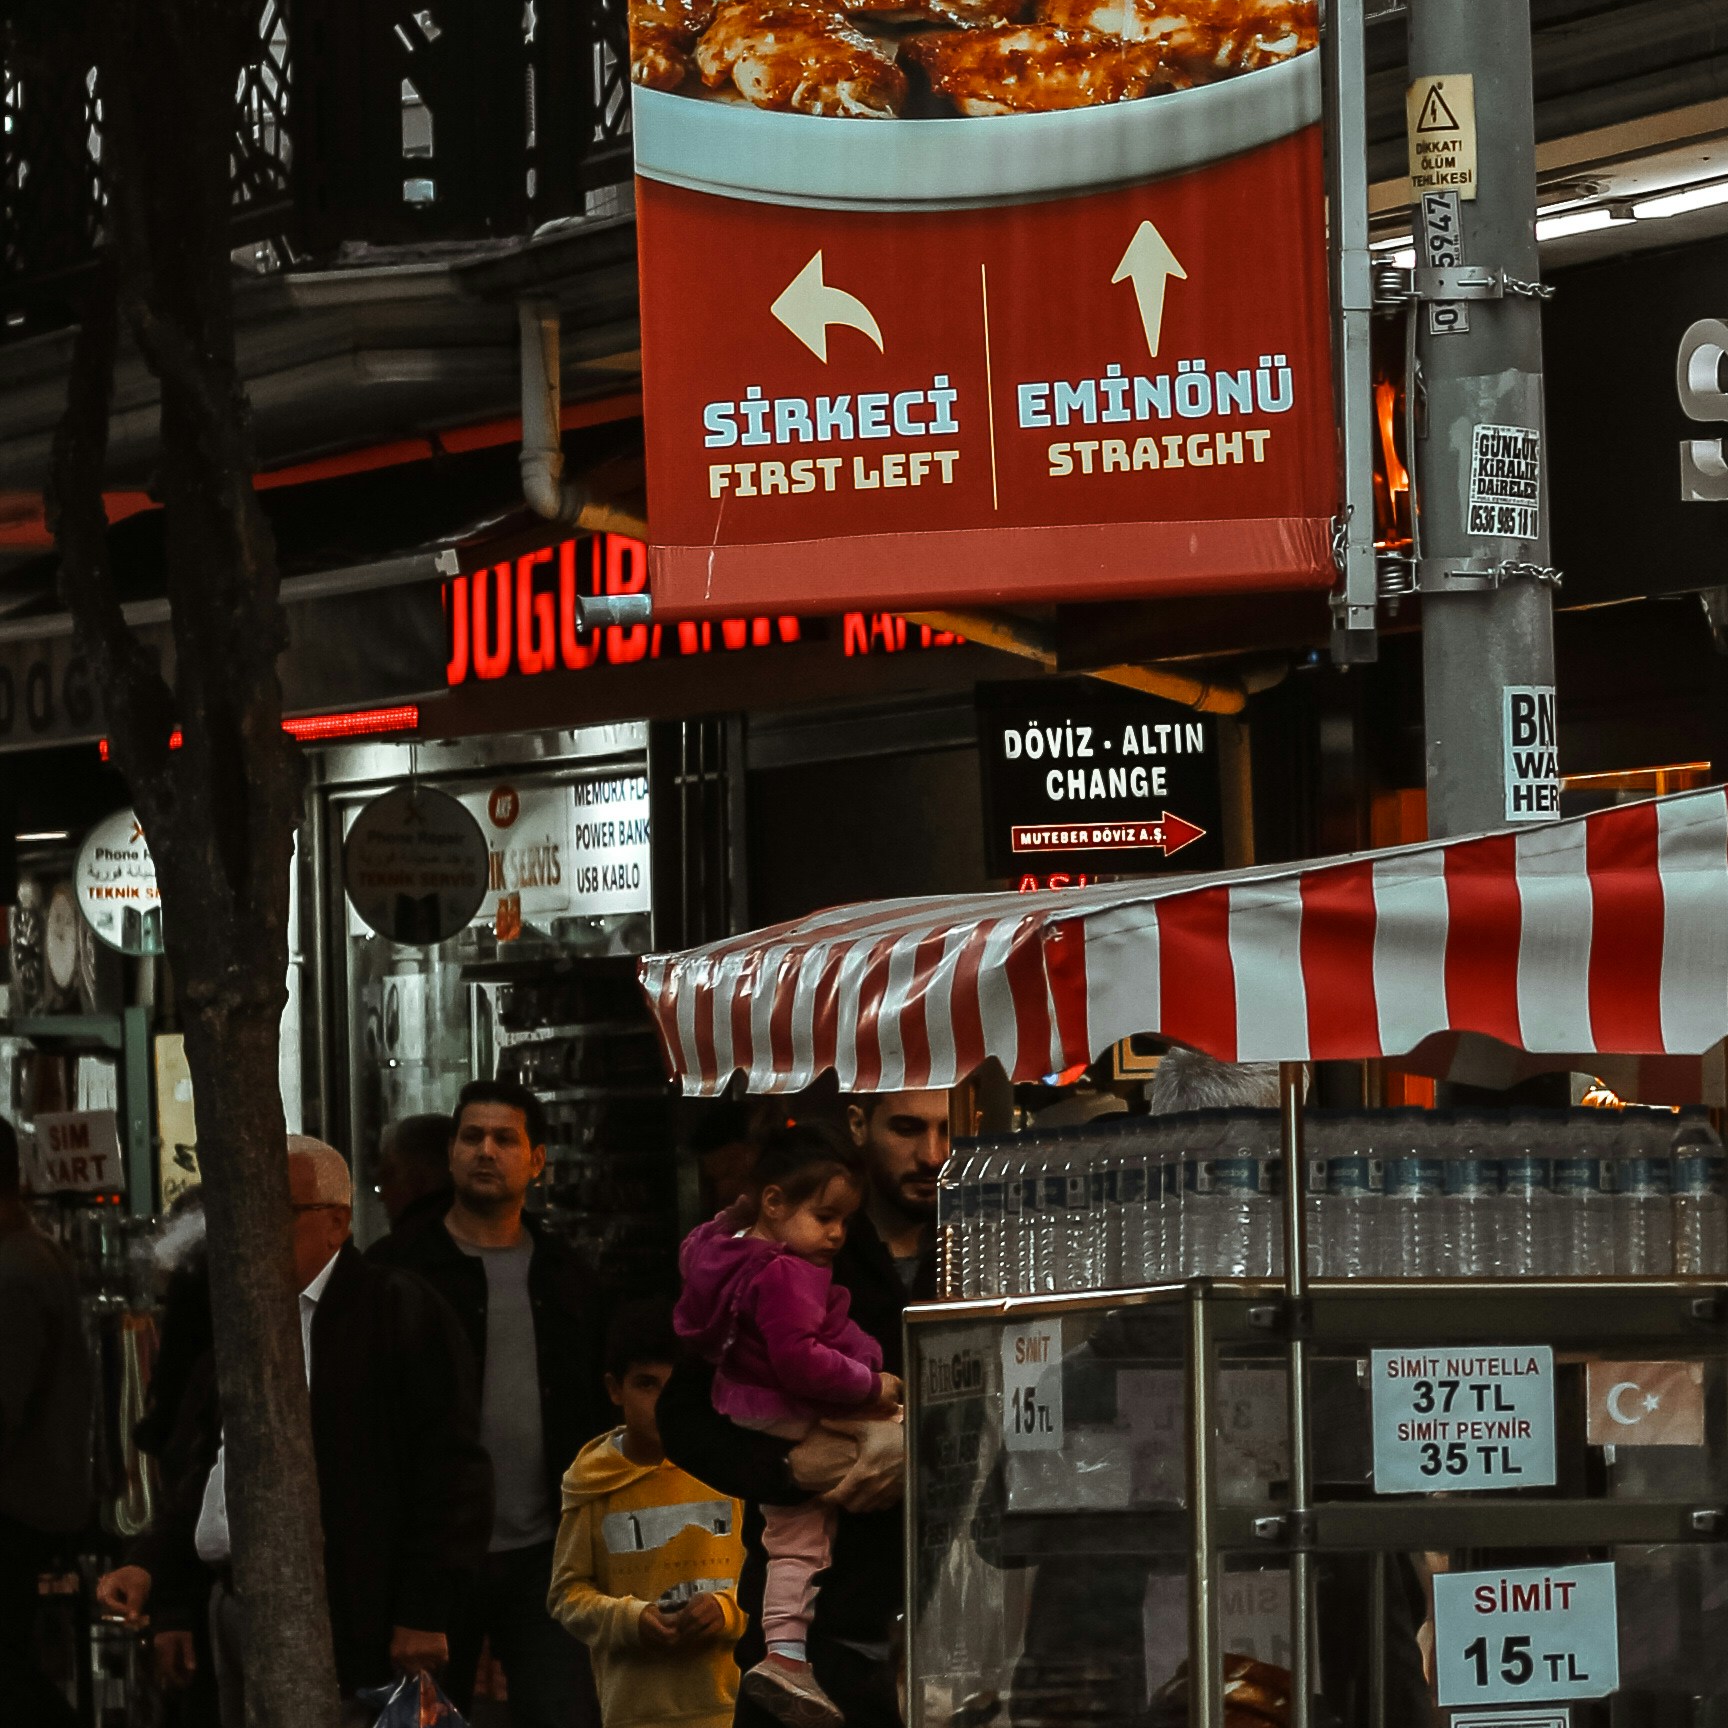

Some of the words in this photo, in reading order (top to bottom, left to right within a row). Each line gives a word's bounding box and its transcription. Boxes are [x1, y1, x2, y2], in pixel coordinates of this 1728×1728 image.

[1415, 139, 1463, 155] DİKKAT!
[1421, 155, 1456, 170] ÖLÜM
[1412, 169, 1472, 187] TEHLİKESİ
[1017, 354, 1294, 428] EMİNÖNÜ
[702, 374, 959, 448] SİRKECİ
[1048, 429, 1271, 476] STRAIGHT
[709, 458, 843, 498] FIRST
[853, 450, 959, 490] LEFT
[1511, 693, 1555, 747] BN
[1004, 719, 1094, 760] DÖVİZ
[1122, 723, 1205, 756] ALTIN
[1512, 752, 1558, 779] WA
[1046, 766, 1169, 802] CHANGE
[1513, 784, 1559, 812] HER
[575, 822, 615, 851] POWER
[1020, 830, 1089, 845] MUTEBER
[1092, 827, 1136, 843] DÖVİZ
[1139, 828, 1167, 843] A.Ş.
[95, 848, 138, 861] Phone
[577, 866, 599, 894] USB
[602, 862, 641, 892] KABLO
[49, 1123, 90, 1152] SIM
[1387, 1355, 1440, 1378] SİMİT
[1447, 1357, 1540, 1377] NUTELLA
[1011, 1386, 1036, 1435] 15
[1038, 1405, 1054, 1433] TL
[1412, 1380, 1460, 1414] 37
[1469, 1383, 1516, 1412] TL
[1398, 1418, 1450, 1441] SİMİT
[1456, 1417, 1532, 1439] PEYNİR
[1419, 1442, 1469, 1476] 35
[1476, 1445, 1523, 1475] TL
[1474, 1577, 1577, 1615] SİMİT
[1464, 1635, 1534, 1687] 15
[1542, 1653, 1589, 1683] TL
